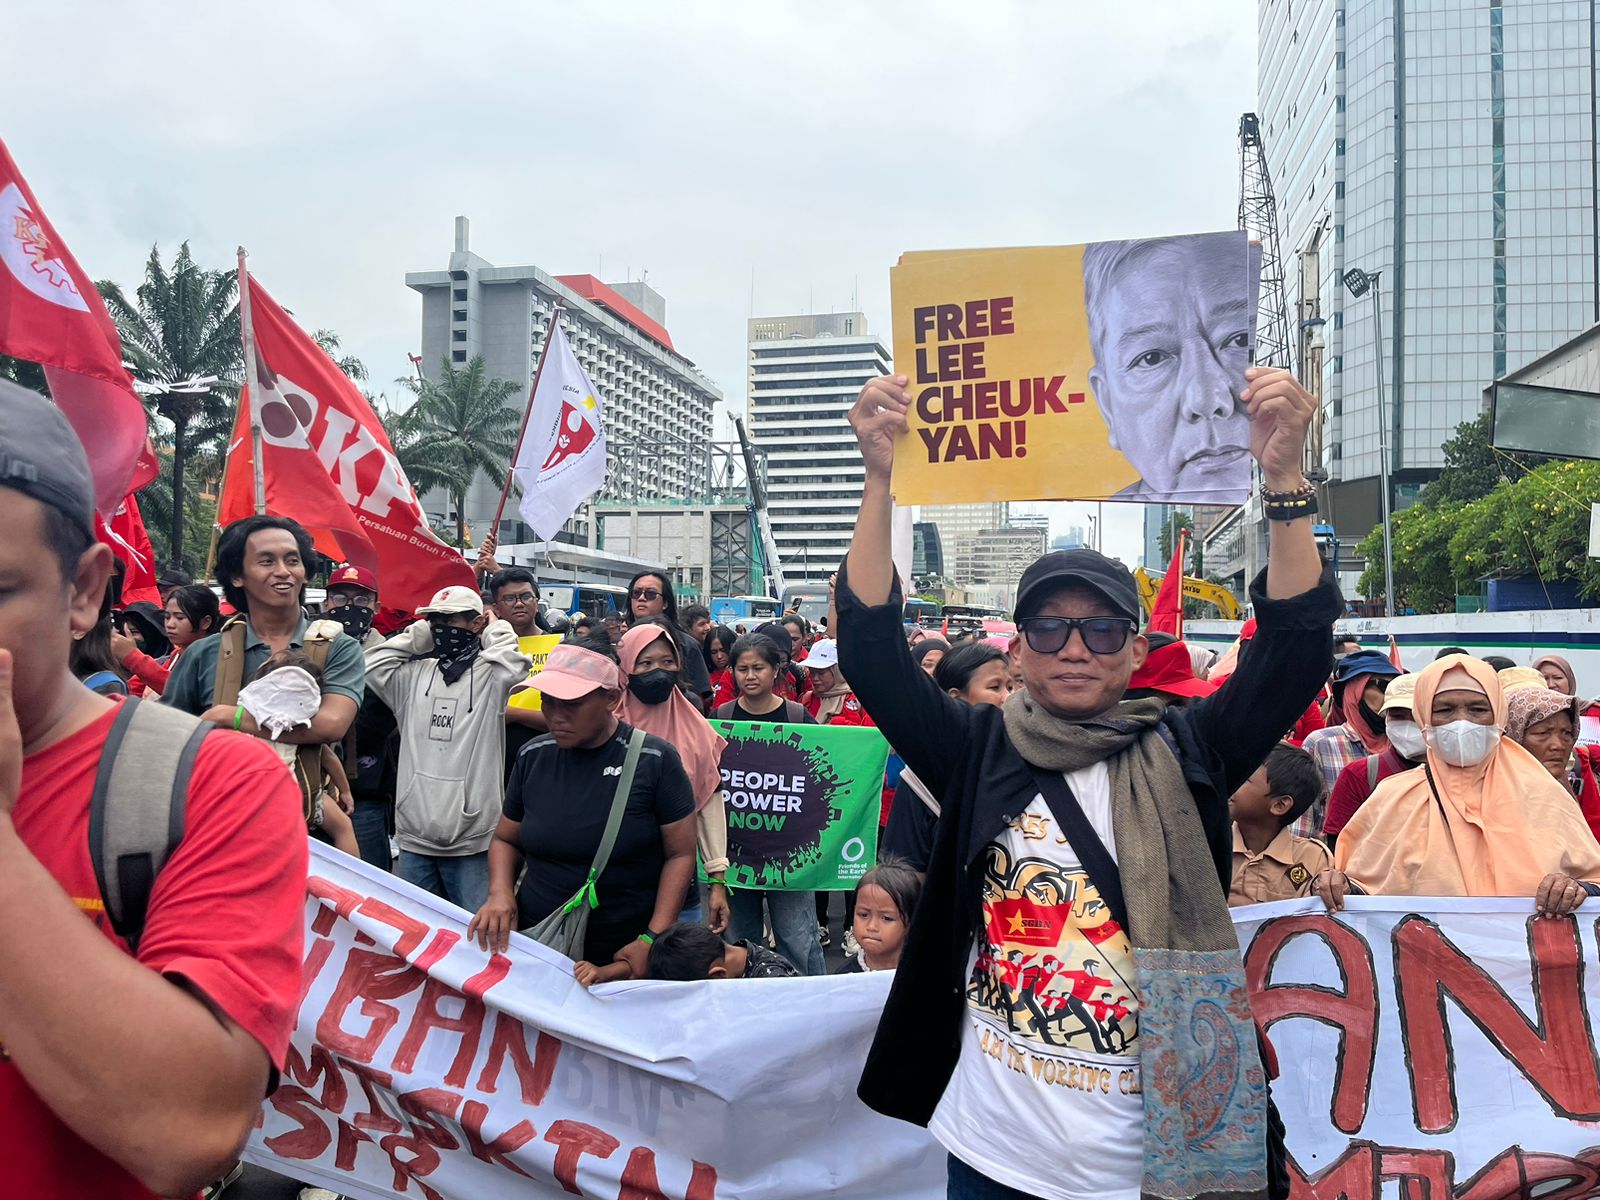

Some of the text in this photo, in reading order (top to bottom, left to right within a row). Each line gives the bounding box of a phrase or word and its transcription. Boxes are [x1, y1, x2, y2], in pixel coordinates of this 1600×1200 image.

[914, 296, 1015, 344] FREE
[915, 341, 986, 384] LEE
[916, 375, 1085, 424] CHEUK-
[917, 420, 1027, 463] YAN!
[358, 515, 408, 541] Persatuan
[409, 536, 439, 555] Buruh
[720, 768, 806, 793] PEOPLE
[722, 789, 802, 813] POWER
[729, 811, 786, 831] NOW
[1031, 1055, 1111, 1095] WORKING
[1118, 1068, 1142, 1095] CL
